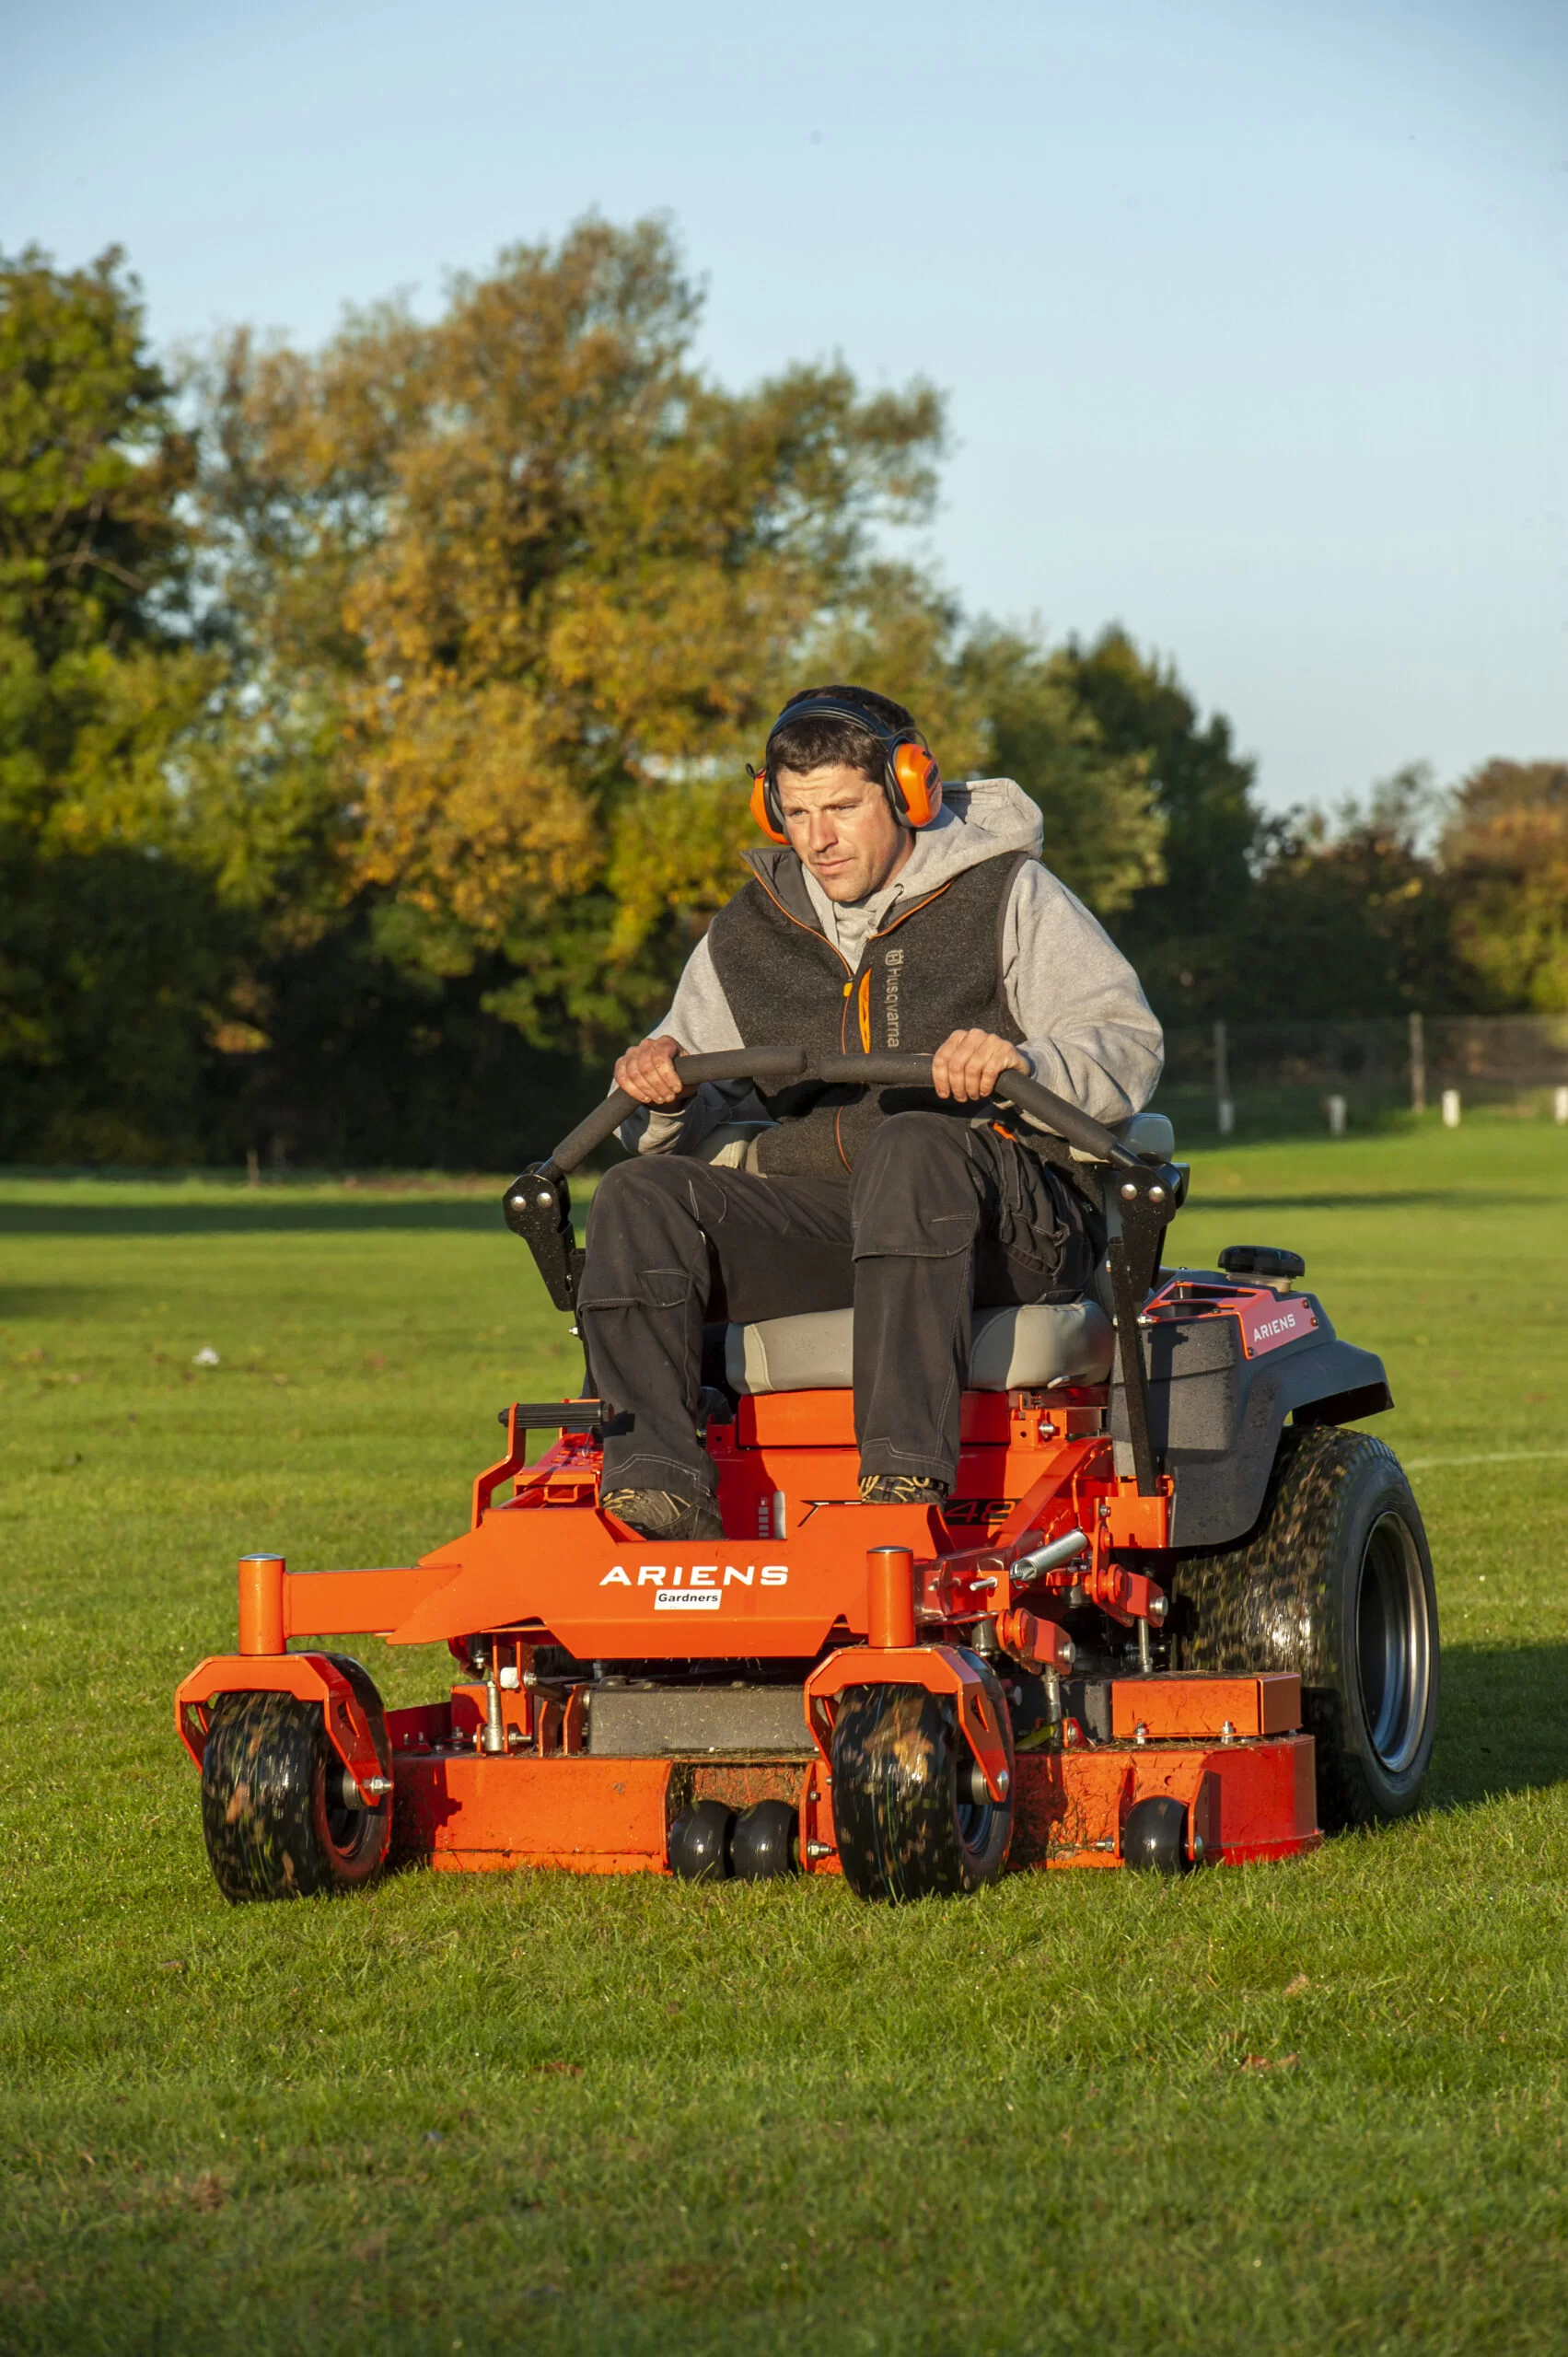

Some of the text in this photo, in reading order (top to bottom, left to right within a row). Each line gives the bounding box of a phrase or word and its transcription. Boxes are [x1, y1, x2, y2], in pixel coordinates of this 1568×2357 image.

[885, 968, 902, 1048] Husqvarna
[1253, 1313, 1296, 1342] ARIENS
[598, 1565, 789, 1585] ARIENS
[658, 1593, 718, 1602] Gardners
